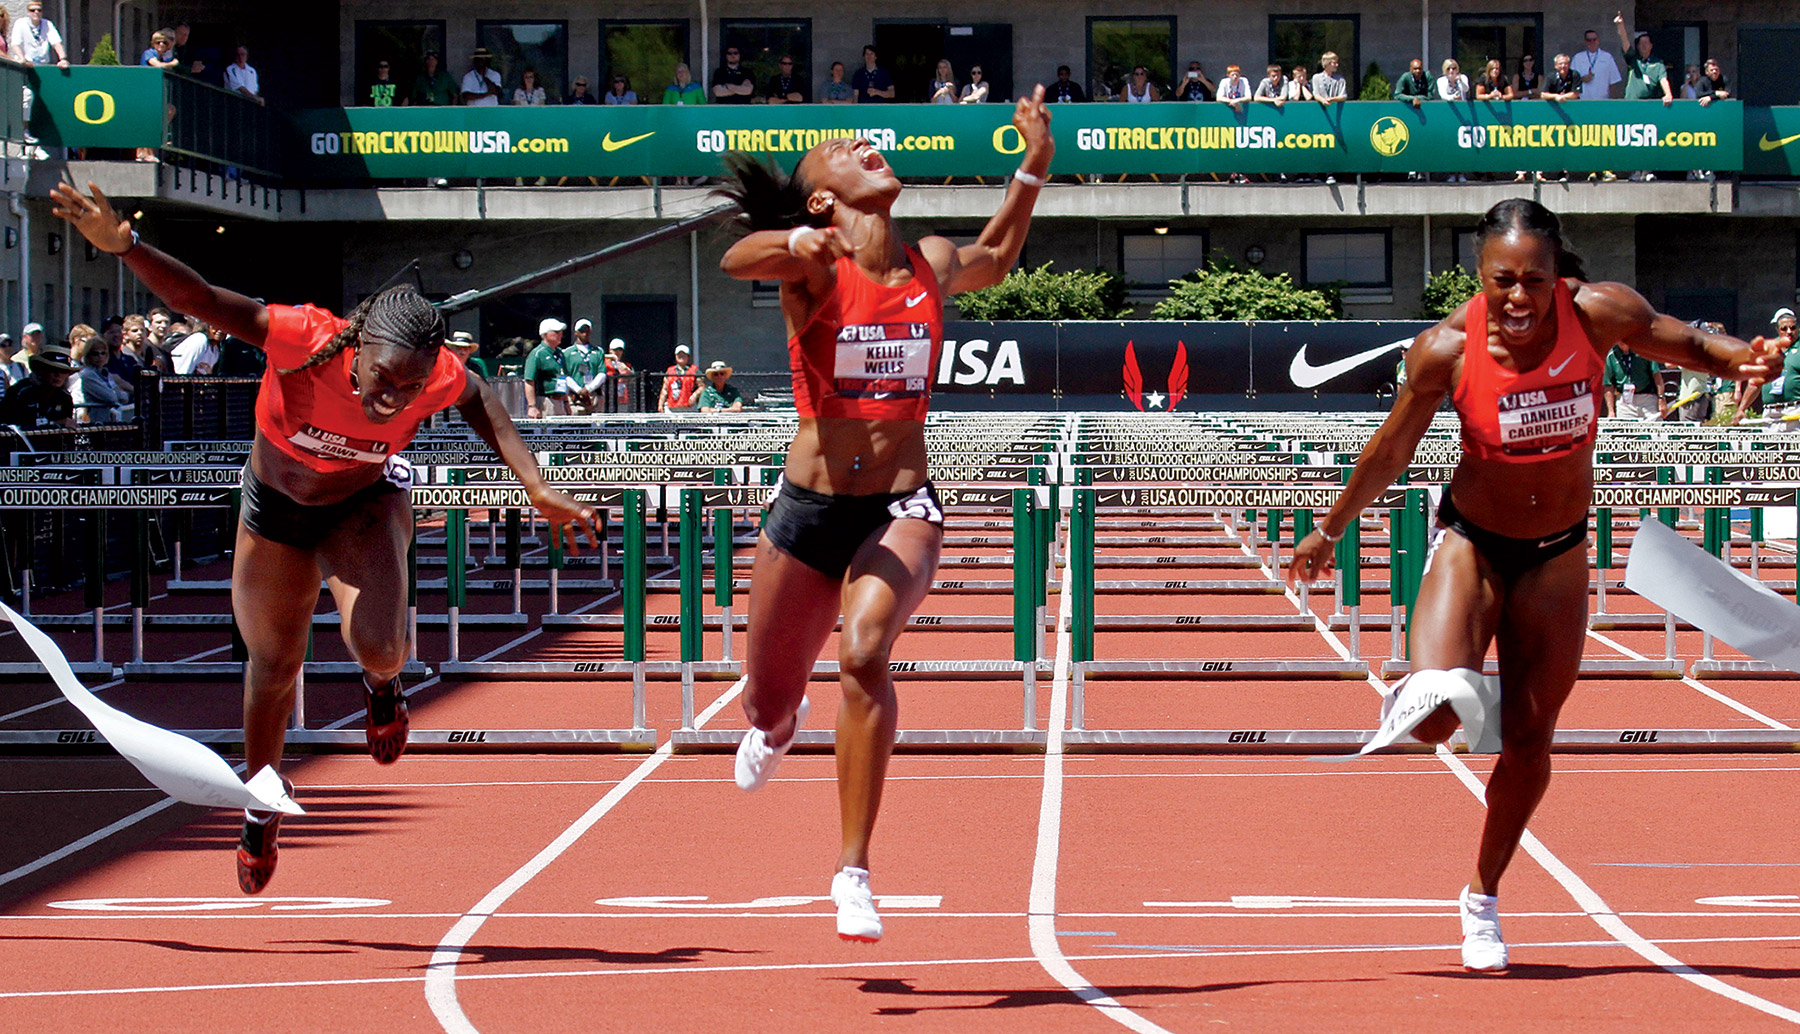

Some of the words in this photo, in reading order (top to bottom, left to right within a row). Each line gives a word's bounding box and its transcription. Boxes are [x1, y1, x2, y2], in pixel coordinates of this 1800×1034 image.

[370, 84, 397, 98] JUST
[1077, 126, 1336, 150] GOTRACKTOWNUSA.com
[1458, 124, 1717, 148] GOTRACKTOWNUSA.com
[311, 131, 569, 154] GOTRACKTOWNUSA.com
[858, 325, 886, 341] USA
[866, 345, 904, 360] KELLIE
[864, 361, 904, 374] WELLS
[937, 340, 1026, 385] ISA
[905, 378, 925, 391] USA
[1519, 390, 1548, 407] USA
[1520, 403, 1577, 425] DANIELLE
[1508, 414, 1589, 440] CARRUTHERS
[320, 432, 347, 446] USA
[216, 443, 232, 452] USA
[233, 443, 254, 452] OUTD
[447, 442, 462, 451] USA
[464, 442, 492, 451] OUTDO
[529, 442, 564, 451] IONSHIPS
[669, 442, 684, 451] USA
[685, 442, 723, 451] OUTDOOR
[724, 442, 786, 451] CHAMPIONSHIPS
[927, 443, 950, 451] DOOR
[950, 443, 1012, 451] CHAMPIONSHIPS
[1120, 443, 1135, 451] USA
[1136, 443, 1173, 451] OUTDOOR
[1174, 443, 1236, 451] CHAMPIONSHIPS
[1344, 443, 1359, 451] USA
[1625, 442, 1687, 451] CHAMPIONSHIPS
[70, 454, 89, 465] USA
[90, 454, 133, 465] OUTDOOR
[134, 453, 206, 464] CHAMPIONSHIPS
[602, 454, 618, 464] USA
[619, 454, 663, 464] OUTDOOR
[665, 454, 737, 464] CHAMPIONSHIPS
[1121, 454, 1139, 465] USA
[1140, 454, 1184, 465] OUTDOOR
[1185, 454, 1257, 464] CHAMPIONSHIPS
[1648, 453, 1666, 463] USA
[1667, 453, 1711, 464] OUTDOOR
[1712, 453, 1784, 463] CHAMPIONSHIPS
[0, 470, 41, 482] NSHIPS
[193, 470, 214, 483] USA
[215, 470, 242, 483] OUTD
[541, 468, 583, 481] UTDOOR
[584, 468, 671, 481] CHAMPIONSHIPS
[927, 468, 984, 481] PIONSHIPS
[1136, 468, 1158, 481] USA
[1159, 468, 1212, 481] OUTDOOR
[1213, 468, 1298, 481] CHAMPIONSHIPS
[1765, 468, 1787, 480] USA
[4, 489, 69, 505] OUTDOOR
[73, 489, 177, 505] CHAMPIONSHIPS
[181, 493, 206, 502] GILL
[464, 489, 533, 506] CHAMPION
[573, 494, 599, 502] GILL
[747, 489, 756, 505] 2011
[961, 493, 987, 502] GILL
[1141, 490, 1150, 506] 2011
[1151, 490, 1177, 506] USA
[1178, 490, 1244, 506] OUTDOOR
[1245, 490, 1342, 507] CHAMPIONSHI
[1591, 489, 1633, 505] DOOR
[1635, 489, 1742, 505] CHAMPIONSHIPS
[1745, 493, 1771, 502] GILL
[941, 581, 964, 589] GILL
[1164, 581, 1188, 589] GILL
[915, 616, 943, 625] GILL
[1175, 616, 1202, 625] GILL
[573, 662, 605, 673] GILL
[888, 661, 918, 672] GILL
[1201, 662, 1233, 673] GILL
[447, 731, 487, 743] GILL
[1227, 731, 1268, 743] GILL
[1619, 730, 1659, 743] GILL
